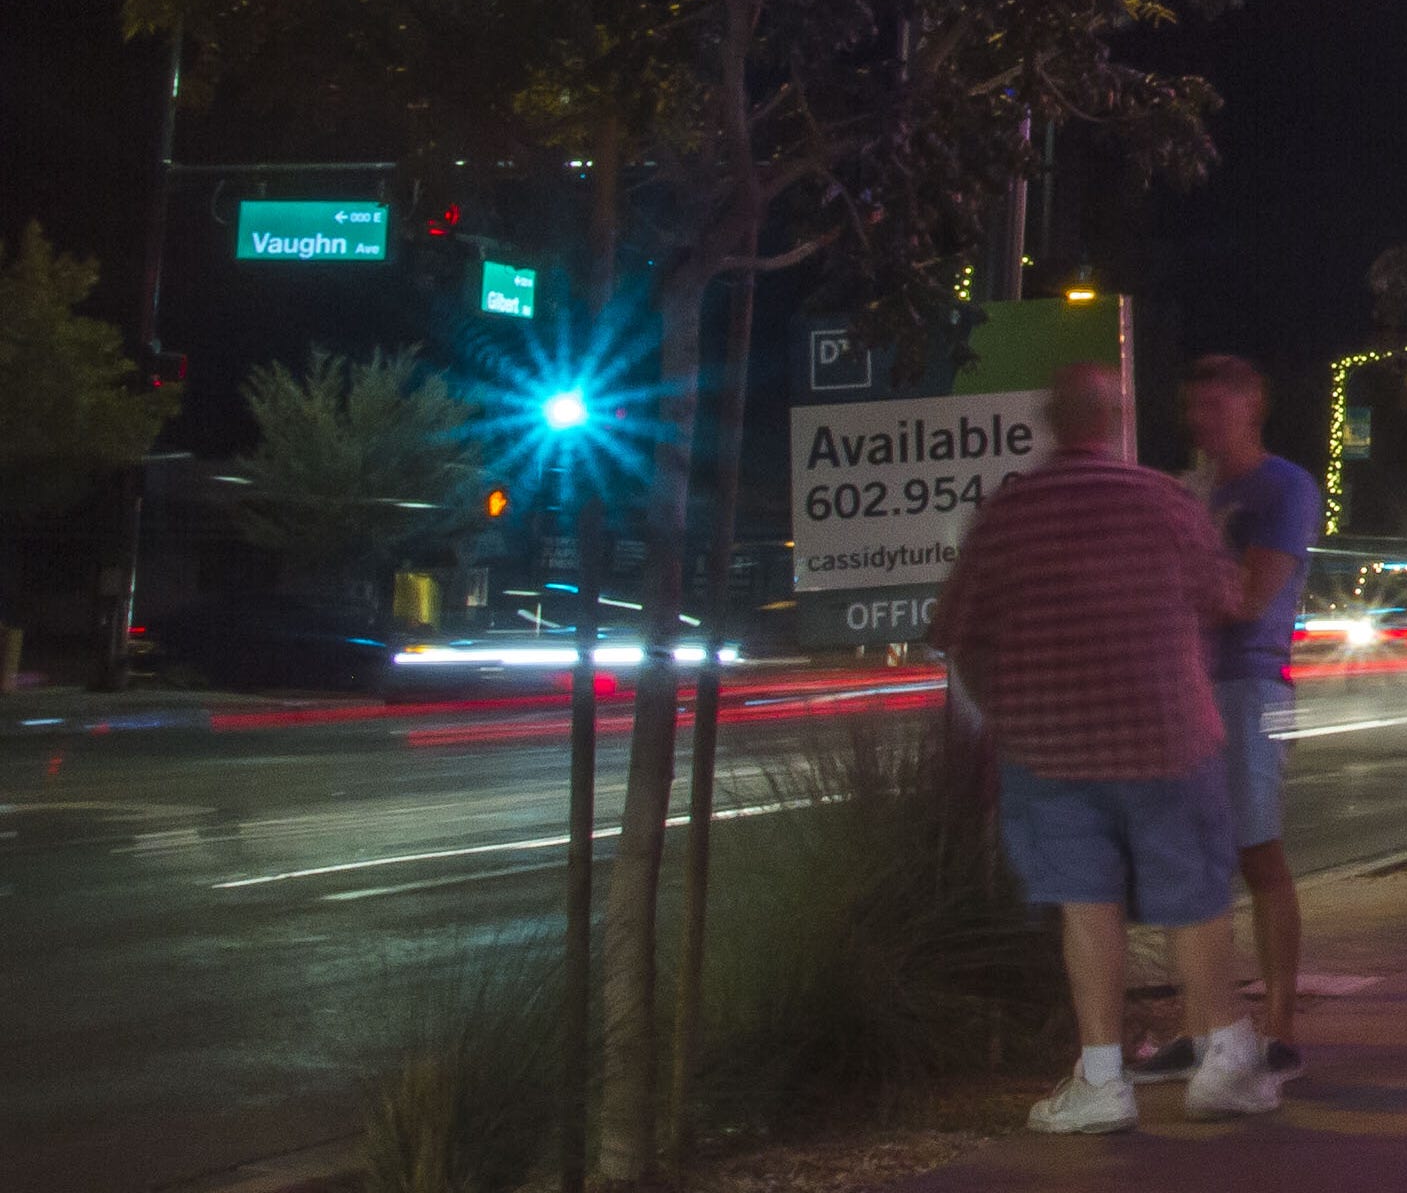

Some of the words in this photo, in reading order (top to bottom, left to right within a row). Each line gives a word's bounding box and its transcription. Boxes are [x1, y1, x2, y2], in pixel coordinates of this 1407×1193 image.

[252, 232, 346, 258] Vaughn
[355, 243, 380, 255] Ave
[806, 414, 1033, 469] Available
[805, 471, 1018, 522] 602.954
